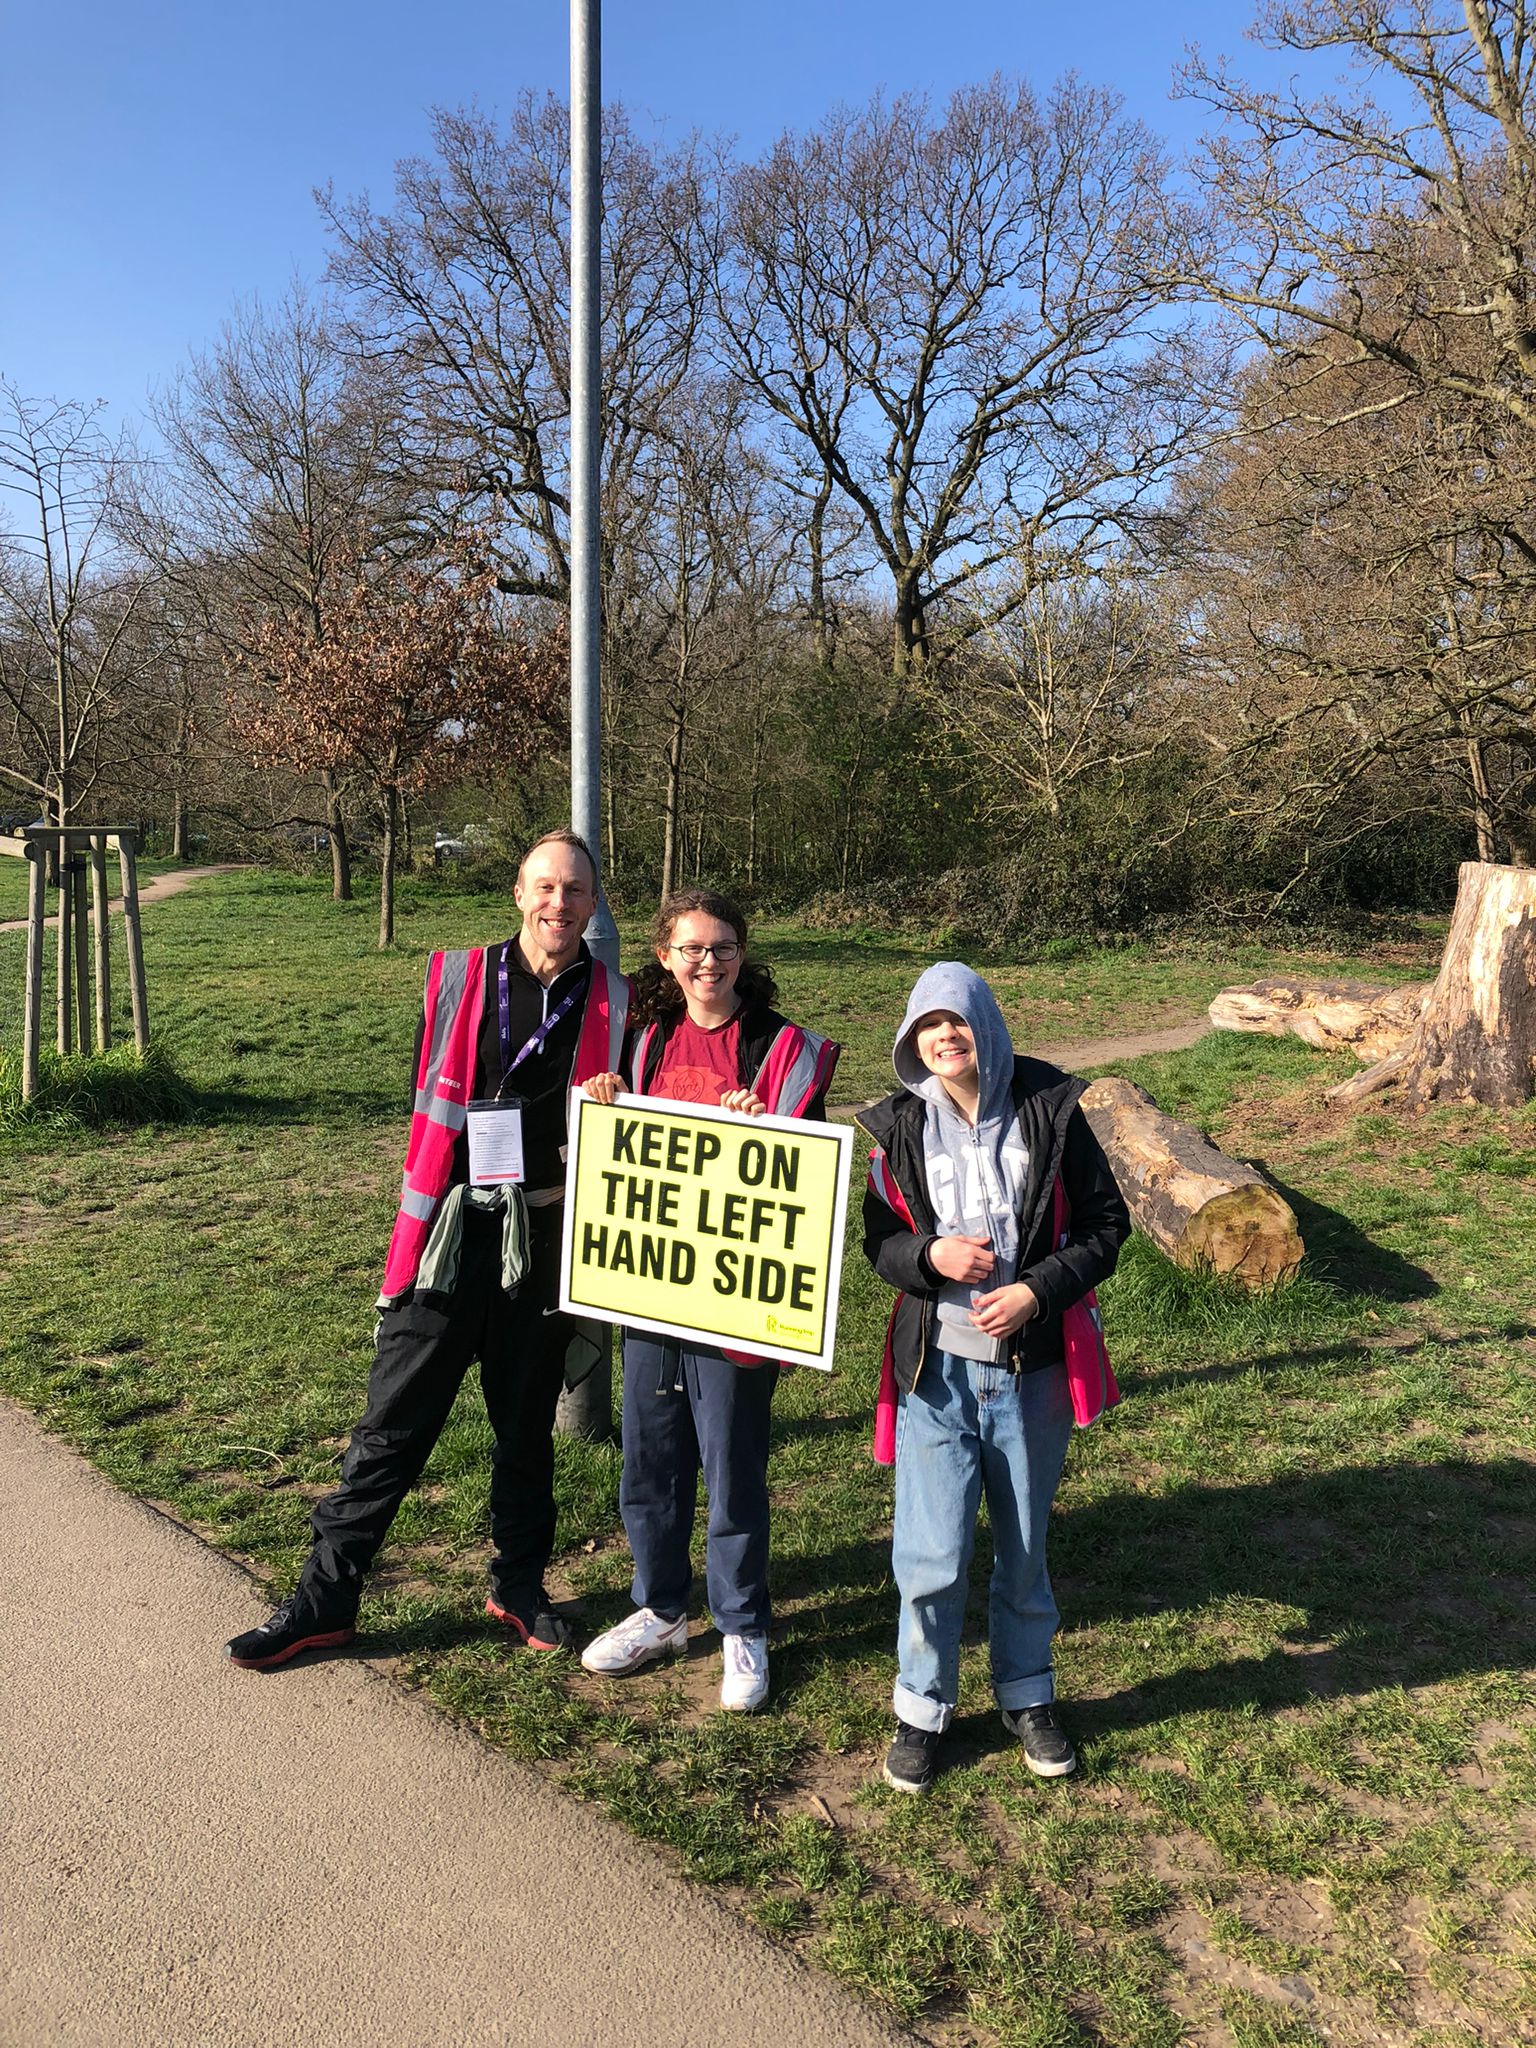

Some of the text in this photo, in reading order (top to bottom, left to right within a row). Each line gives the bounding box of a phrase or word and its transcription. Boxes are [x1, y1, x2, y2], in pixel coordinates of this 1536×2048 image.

[612, 1118, 800, 1193] KEEP ON
[601, 1170, 806, 1250] THE LEFT
[582, 1222, 817, 1312] HAND SIDE
